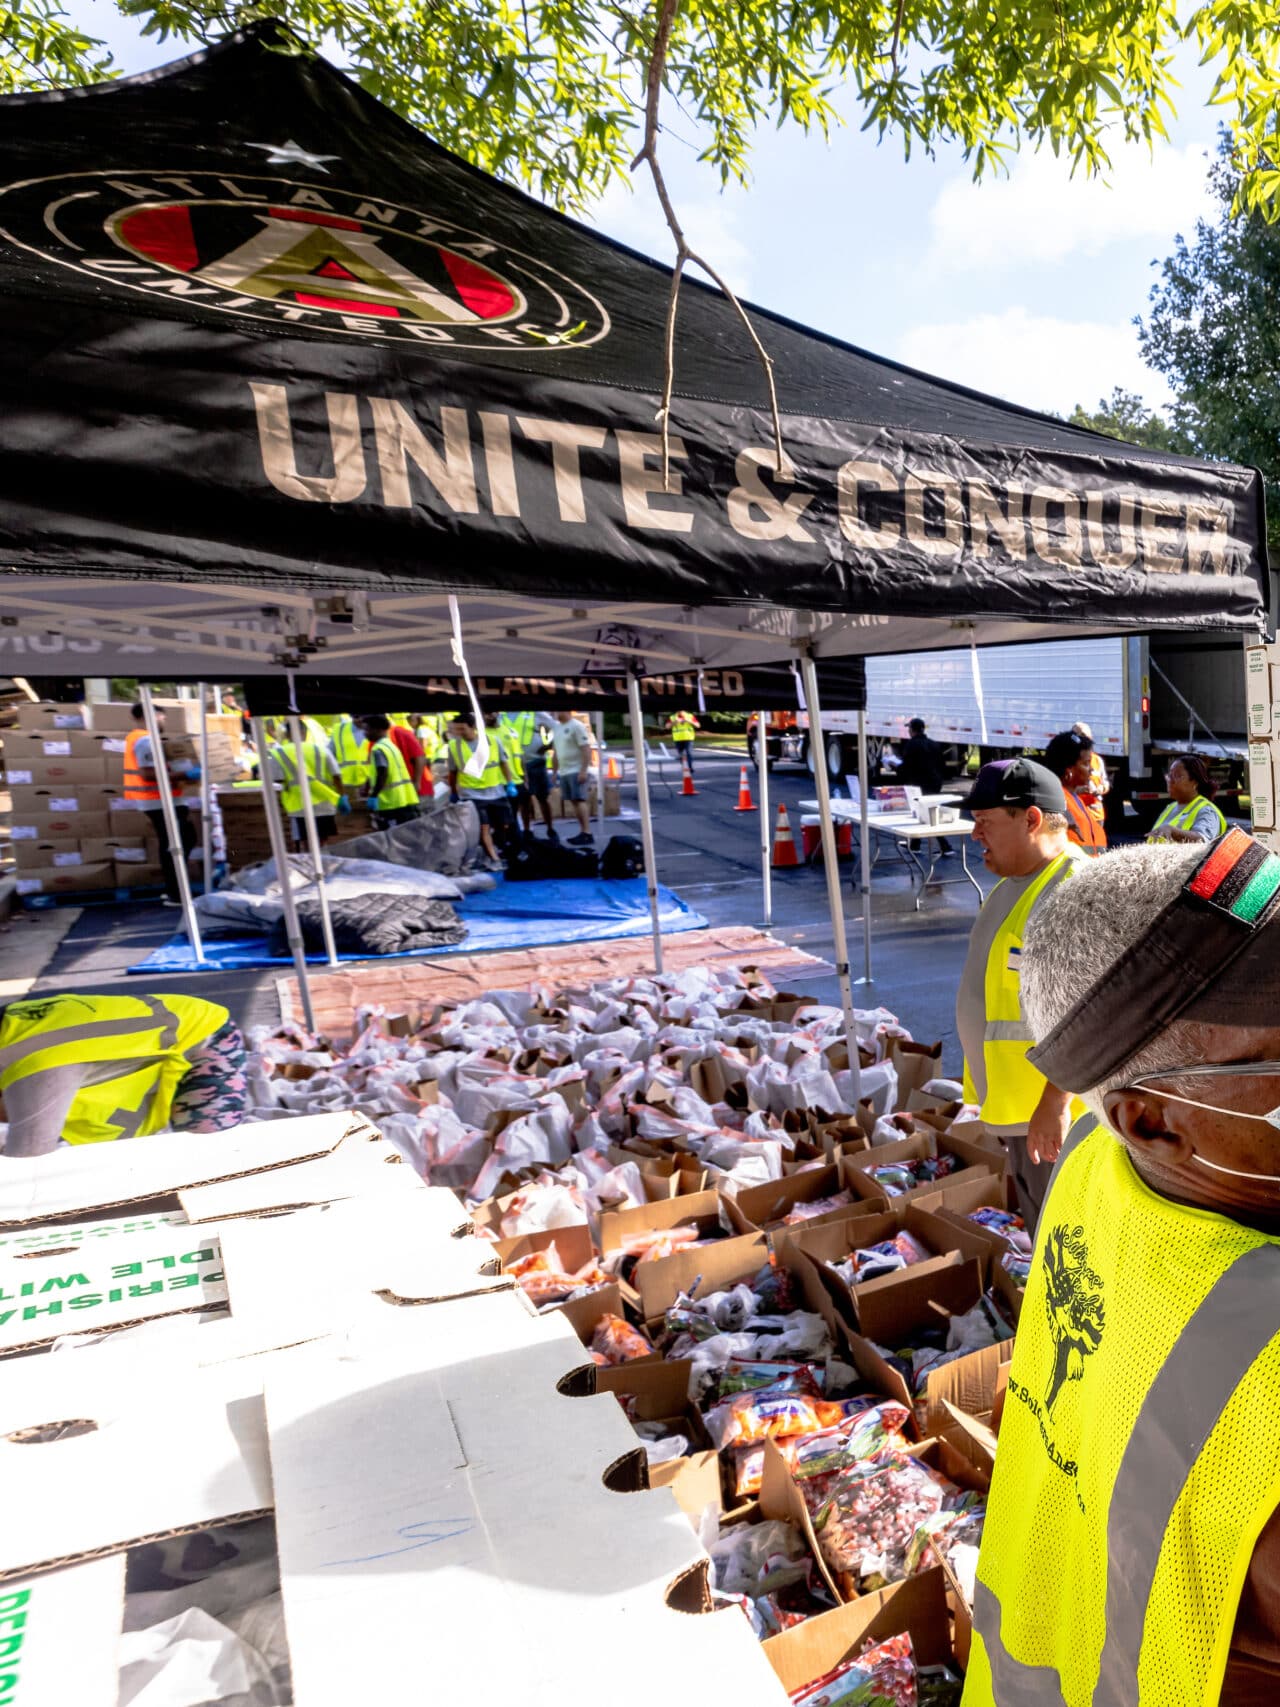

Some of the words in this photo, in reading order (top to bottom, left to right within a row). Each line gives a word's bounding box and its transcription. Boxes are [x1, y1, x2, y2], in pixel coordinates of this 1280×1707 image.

[109, 176, 499, 259] ATLANTA
[81, 258, 456, 341] UNITED
[249, 381, 695, 532] UNITE
[727, 447, 817, 543] &
[838, 459, 1229, 576] CONQUER
[615, 671, 745, 697] UNITED
[111, 1247, 222, 1279] DLE
